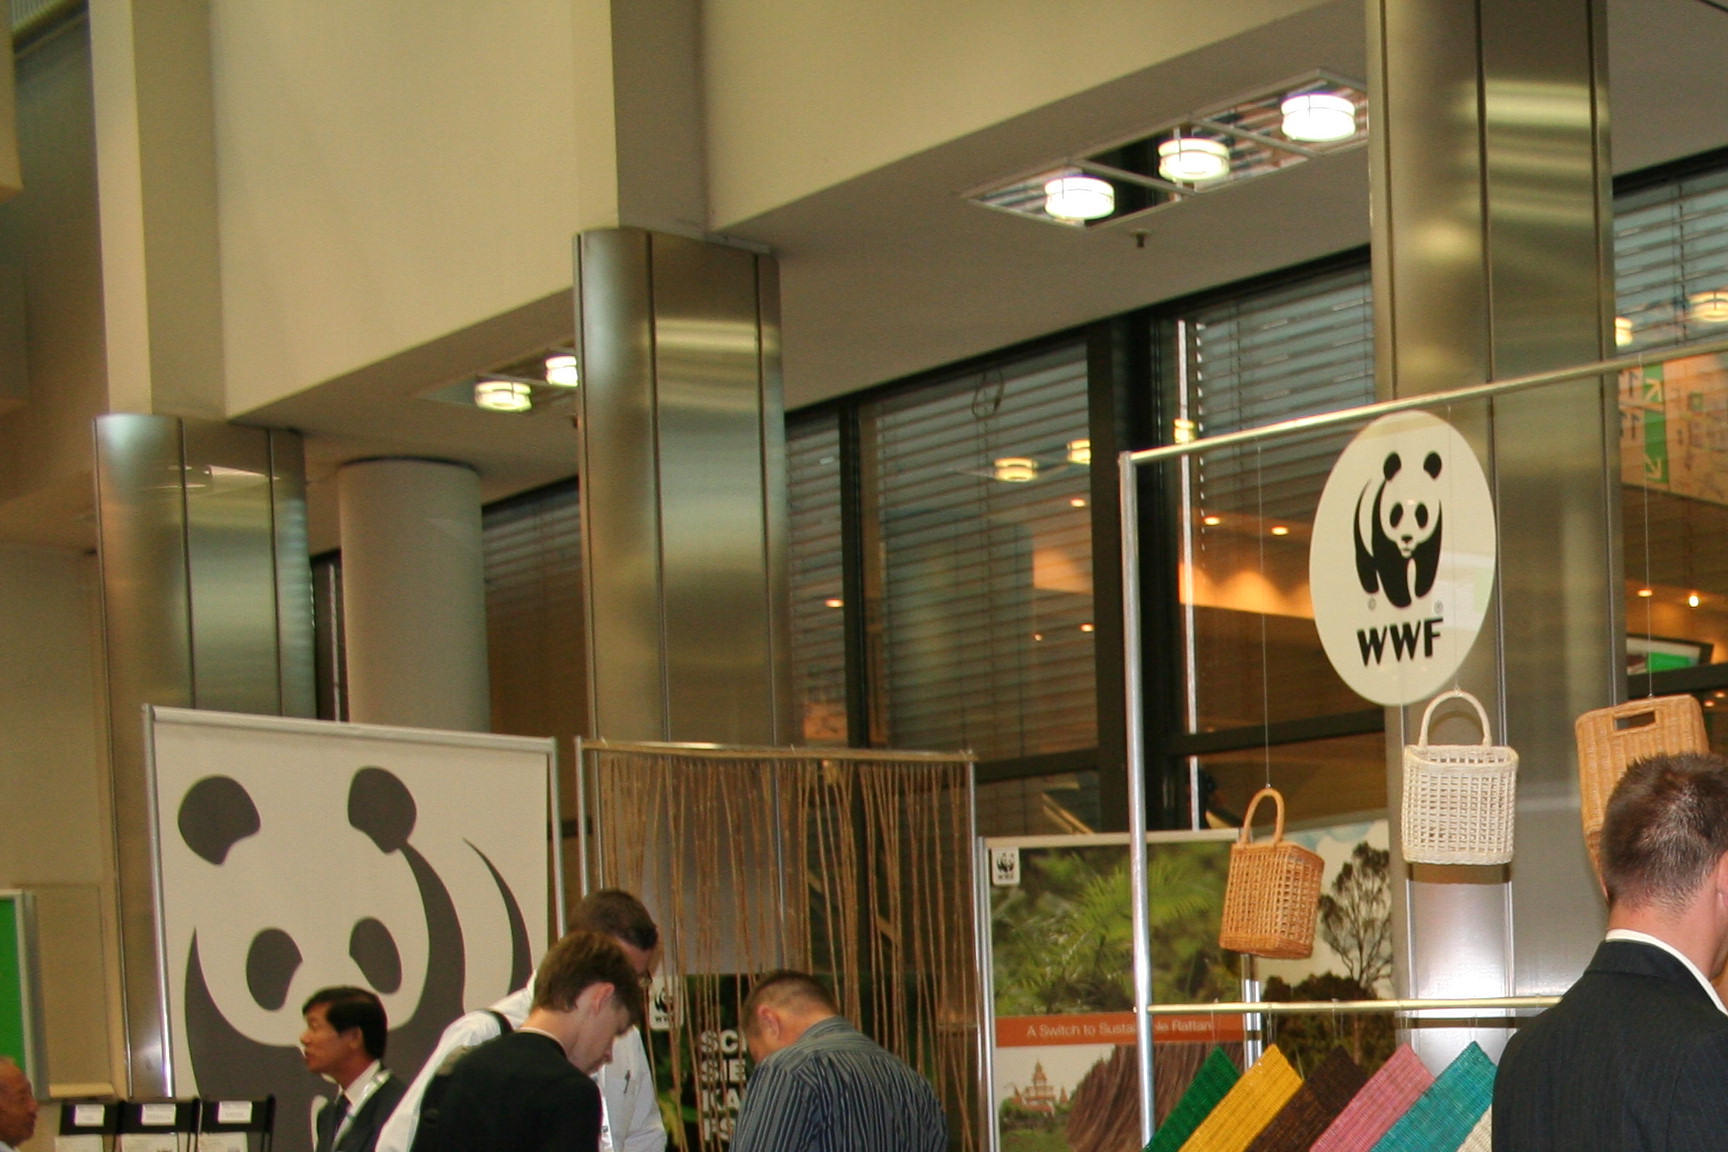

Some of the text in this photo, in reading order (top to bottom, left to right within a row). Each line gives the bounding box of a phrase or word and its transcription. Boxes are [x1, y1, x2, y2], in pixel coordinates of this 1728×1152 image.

[1356, 617, 1444, 667] WWF
[1027, 1025, 1036, 1037] A
[1039, 1023, 1080, 1037] Switch
[1083, 1024, 1096, 1036] to
[1172, 1019, 1212, 1032] Rattan
[701, 1058, 746, 1082] SIE
